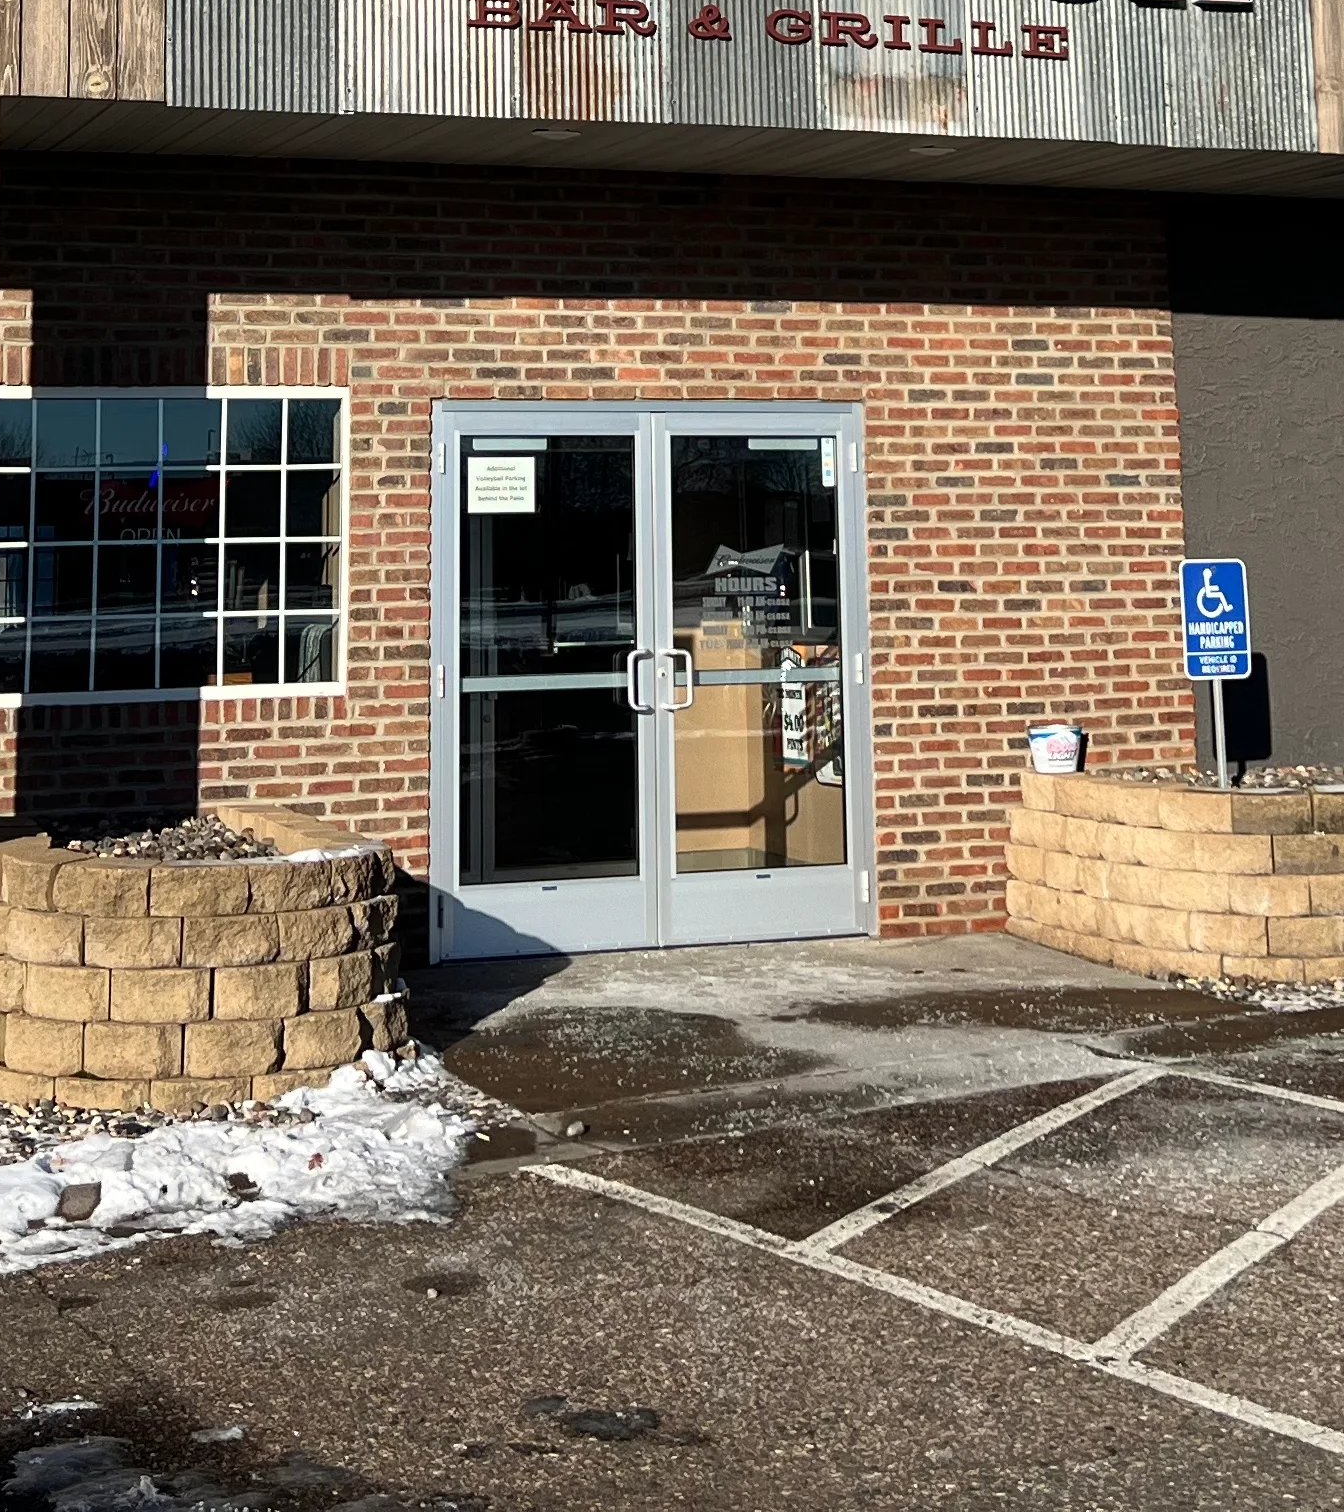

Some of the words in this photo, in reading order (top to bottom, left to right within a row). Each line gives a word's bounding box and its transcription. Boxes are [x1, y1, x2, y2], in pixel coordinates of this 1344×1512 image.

[687, 2, 732, 42] &
[764, 8, 1069, 61] GRILLE
[79, 487, 218, 515] Budweiser
[714, 576, 777, 592] HOURS
[1188, 621, 1244, 635] HANDICAPPED
[1199, 635, 1234, 649] PARKING
